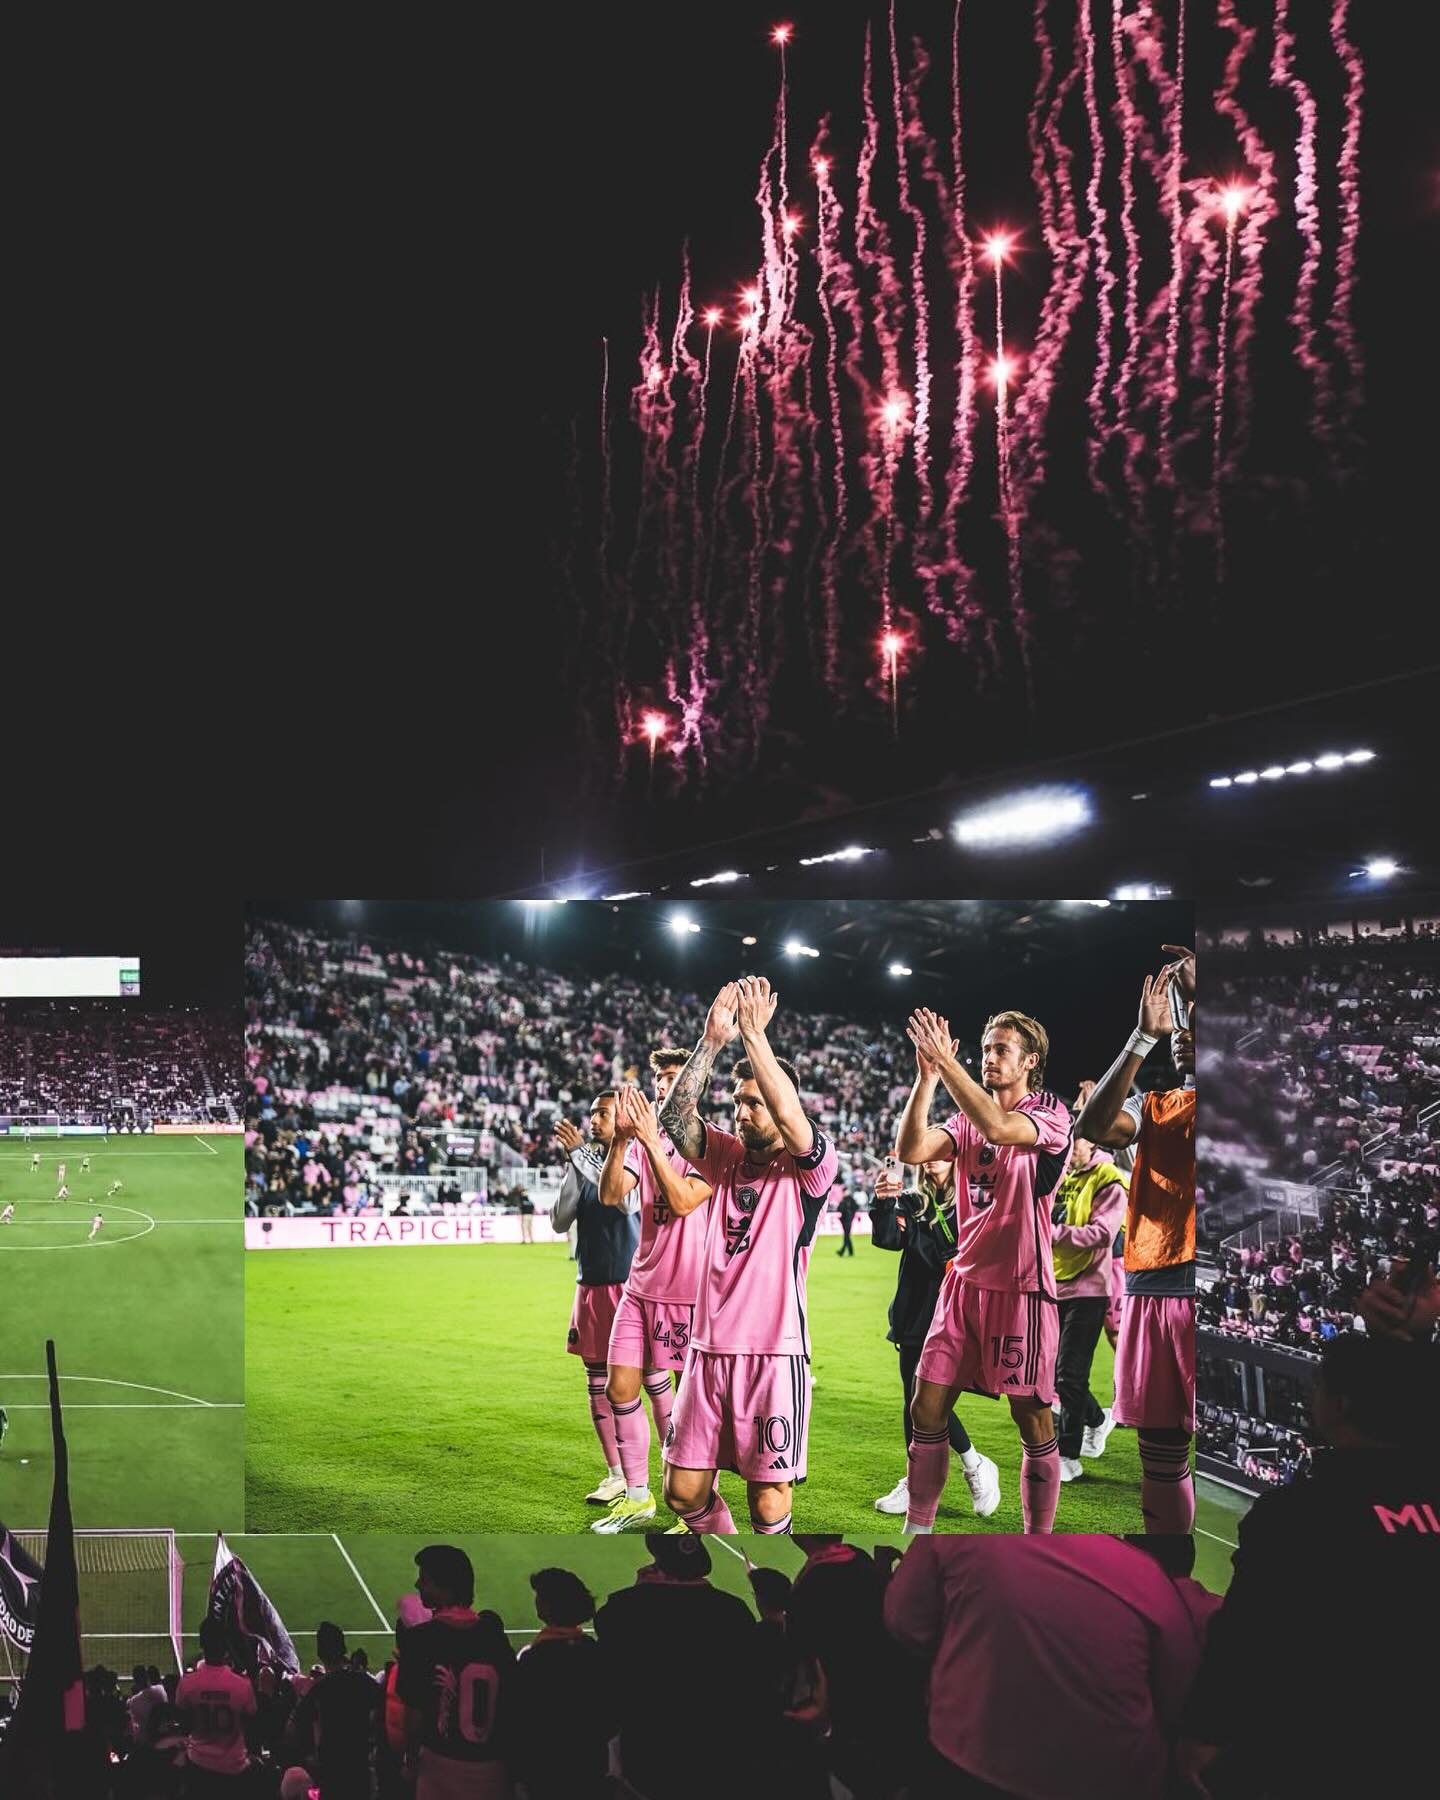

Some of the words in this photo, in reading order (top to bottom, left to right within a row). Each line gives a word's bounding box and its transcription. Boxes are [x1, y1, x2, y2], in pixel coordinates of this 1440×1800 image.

[321, 1220, 495, 1242] TRAPICHE
[653, 1321, 689, 1349] 43
[992, 1336, 1024, 1369] 15
[753, 1416, 791, 1454] 10
